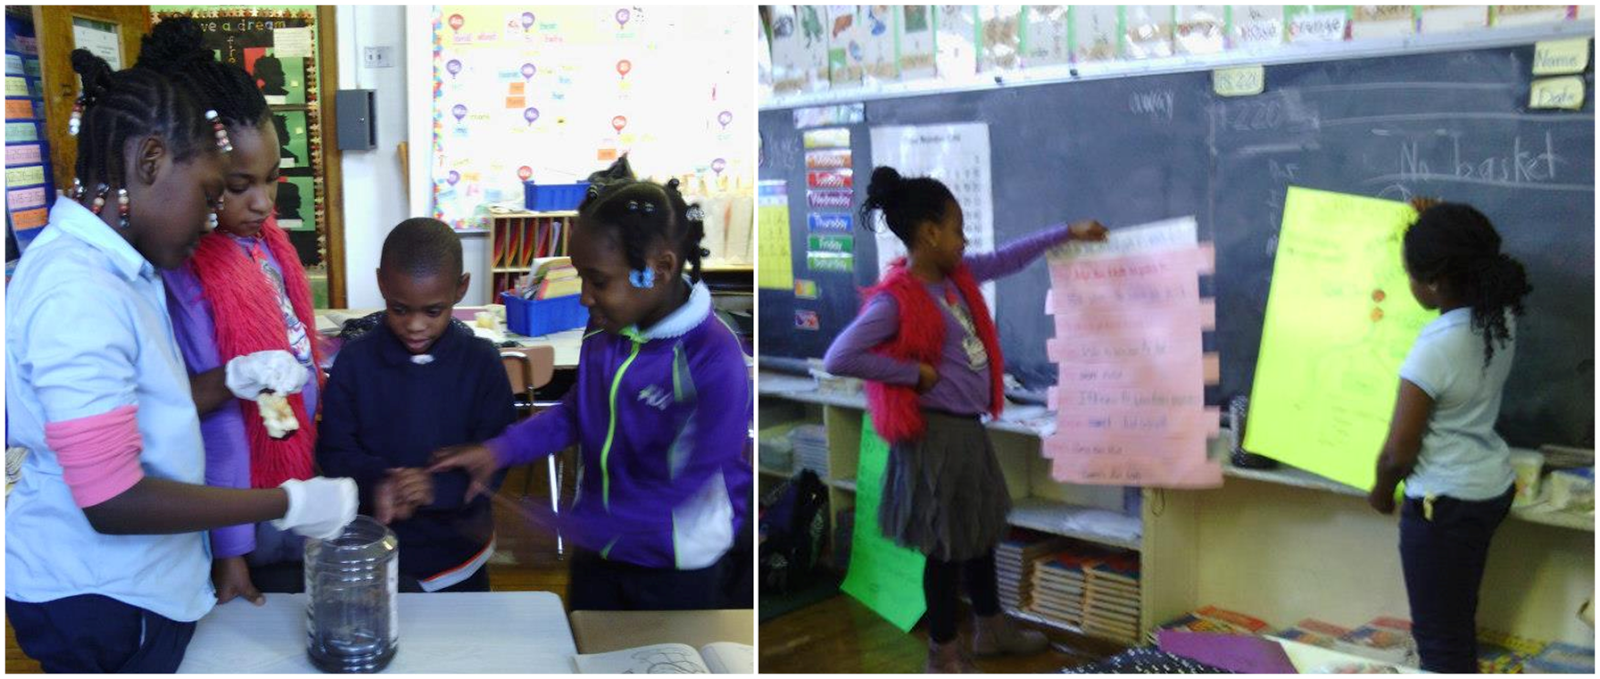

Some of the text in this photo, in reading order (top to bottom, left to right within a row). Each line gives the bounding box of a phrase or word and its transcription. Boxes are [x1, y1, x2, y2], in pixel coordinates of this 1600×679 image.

[222, 22, 232, 31] a
[238, 19, 286, 31] dream
[1535, 49, 1577, 67] Name
[1539, 86, 1574, 105] Date
[1454, 130, 1567, 183] basket
[814, 213, 847, 230] Thursday
[819, 236, 842, 251] Friday
